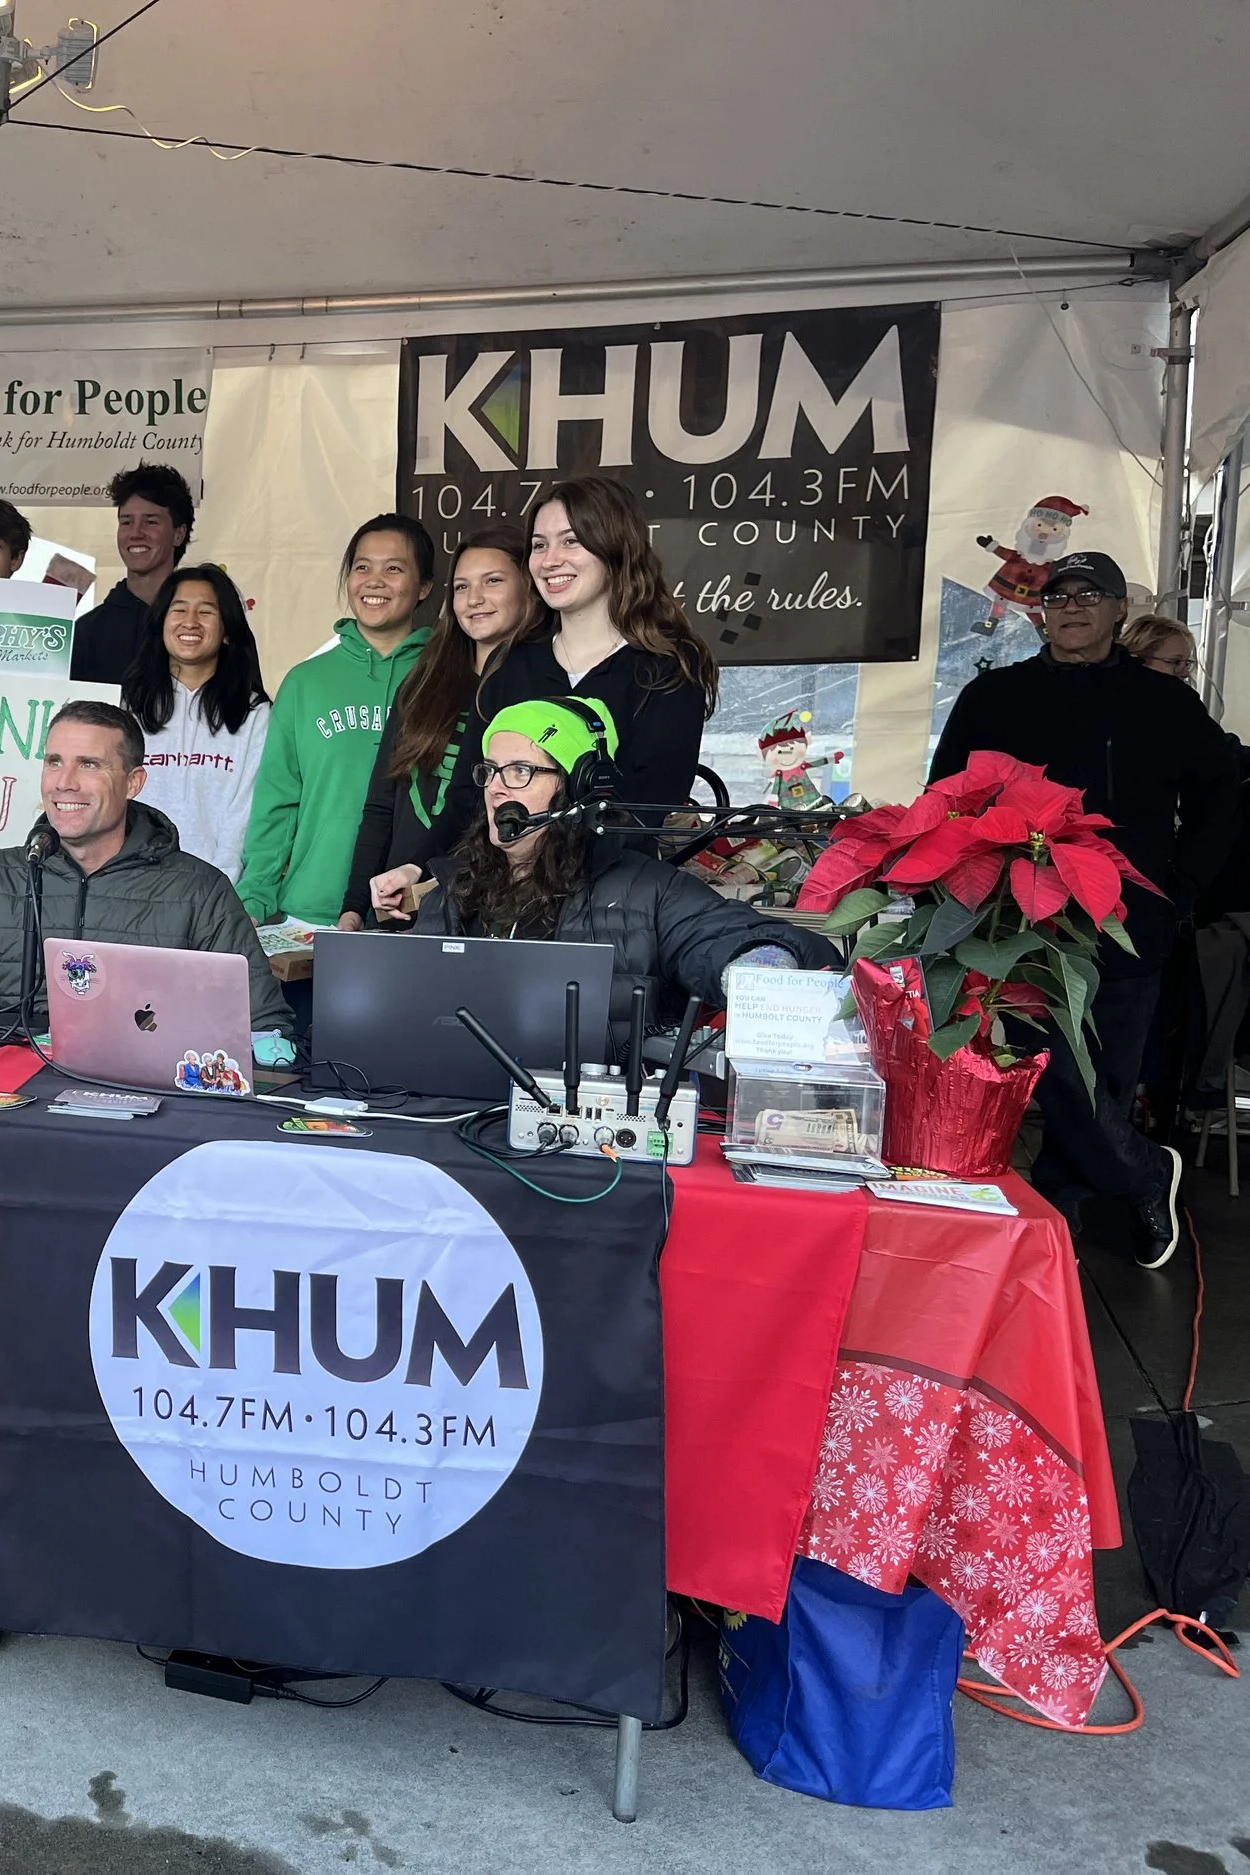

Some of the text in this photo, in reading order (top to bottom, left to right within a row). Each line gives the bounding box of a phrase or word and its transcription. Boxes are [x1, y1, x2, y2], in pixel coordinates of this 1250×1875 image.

[4, 380, 62, 416] for
[73, 378, 207, 427] People
[414, 324, 910, 475] KHUM
[15, 430, 43, 455] for
[46, 430, 137, 450] Humboldt
[142, 431, 203, 455] County
[412, 464, 910, 521] 104.7 104.3FM
[698, 514, 906, 547] COUNTY
[696, 575, 755, 613] the
[766, 570, 864, 613] rules.
[755, 973, 784, 986] Food
[786, 974, 802, 986] for
[807, 976, 844, 989] People
[742, 1012, 785, 1021] HUMBOLT
[786, 1014, 822, 1023] COUNTY
[760, 1004, 780, 1012] END
[782, 1005, 821, 1014] HUNGER
[109, 1256, 530, 1390] KHUM
[132, 1386, 497, 1448] 104.7FM 104.3FM
[189, 1459, 433, 1504] HUMBOLDT
[218, 1497, 403, 1535] COUNTY
